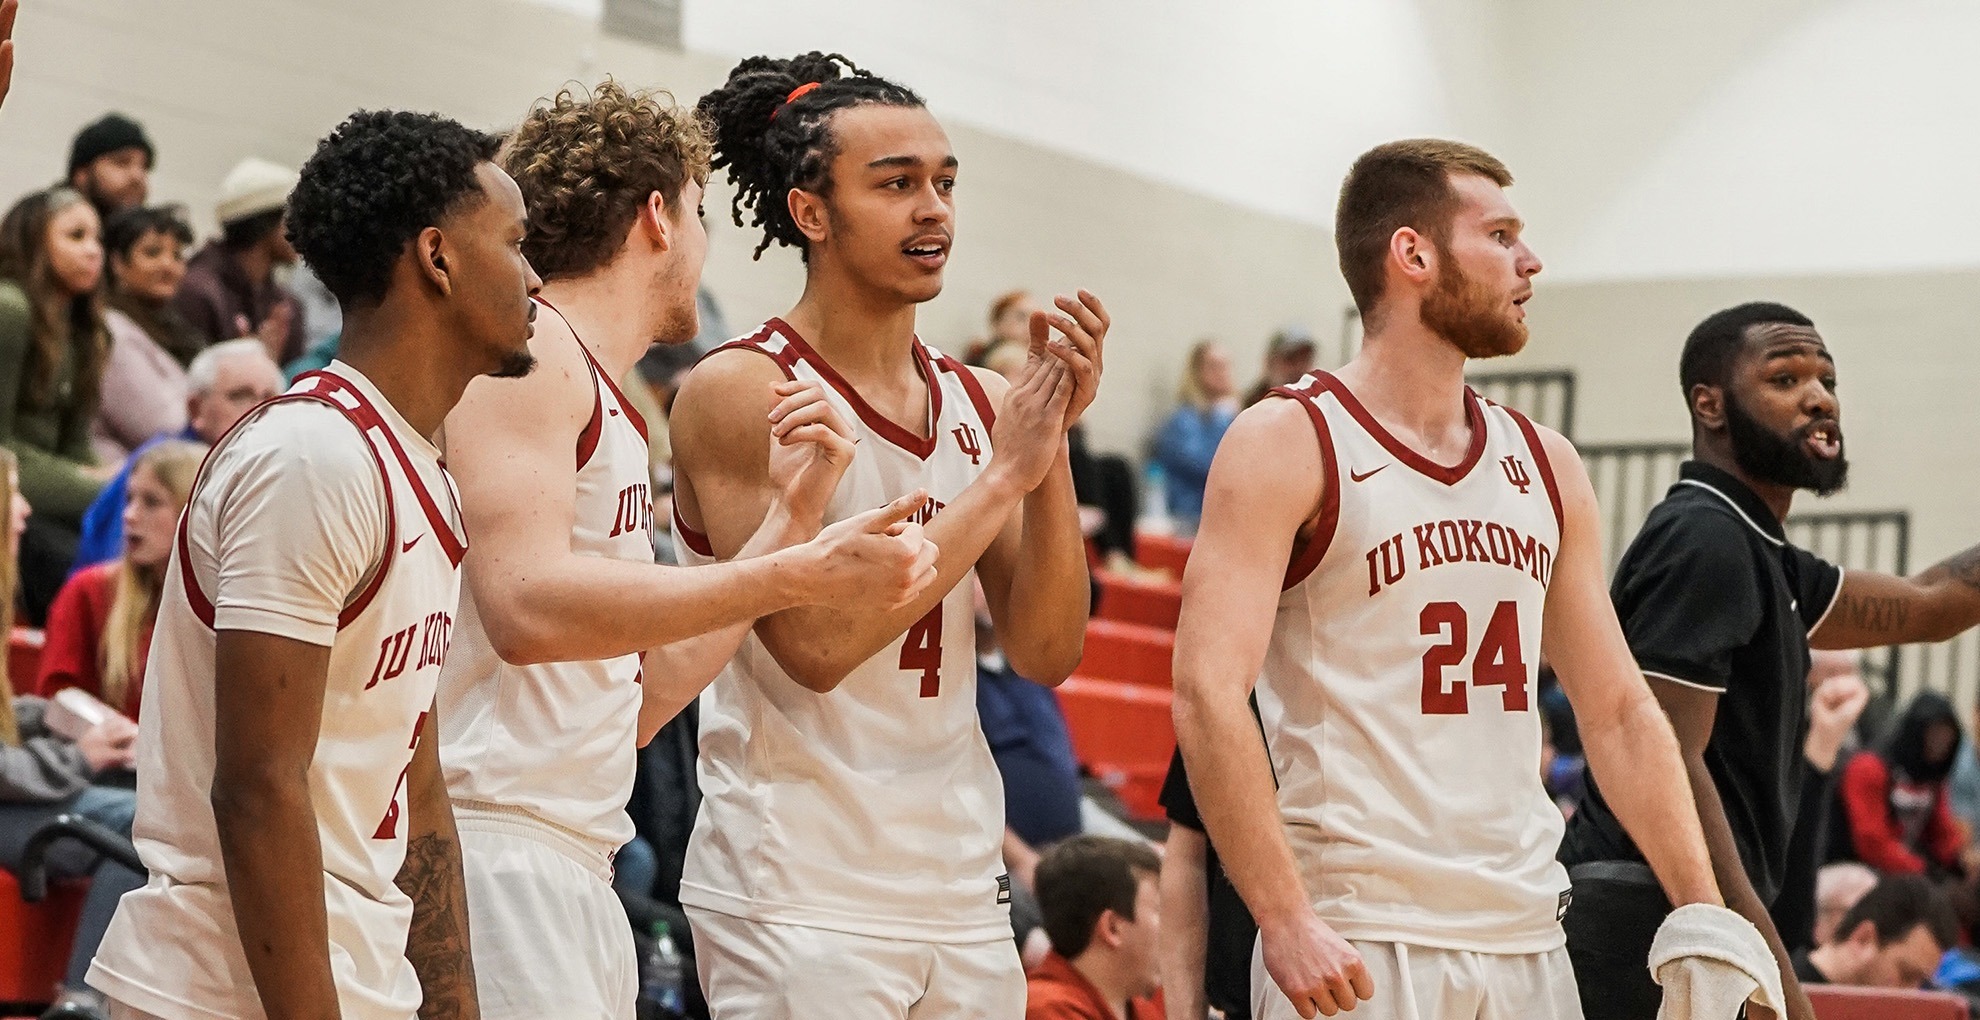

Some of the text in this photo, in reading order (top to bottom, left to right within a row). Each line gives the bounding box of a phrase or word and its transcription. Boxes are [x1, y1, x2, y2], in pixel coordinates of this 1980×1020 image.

[609, 484, 637, 538] IU
[1366, 519, 1551, 597] IU KOKOMO
[364, 623, 417, 690] IU
[898, 599, 943, 697] 4
[1419, 601, 1528, 714] 24
